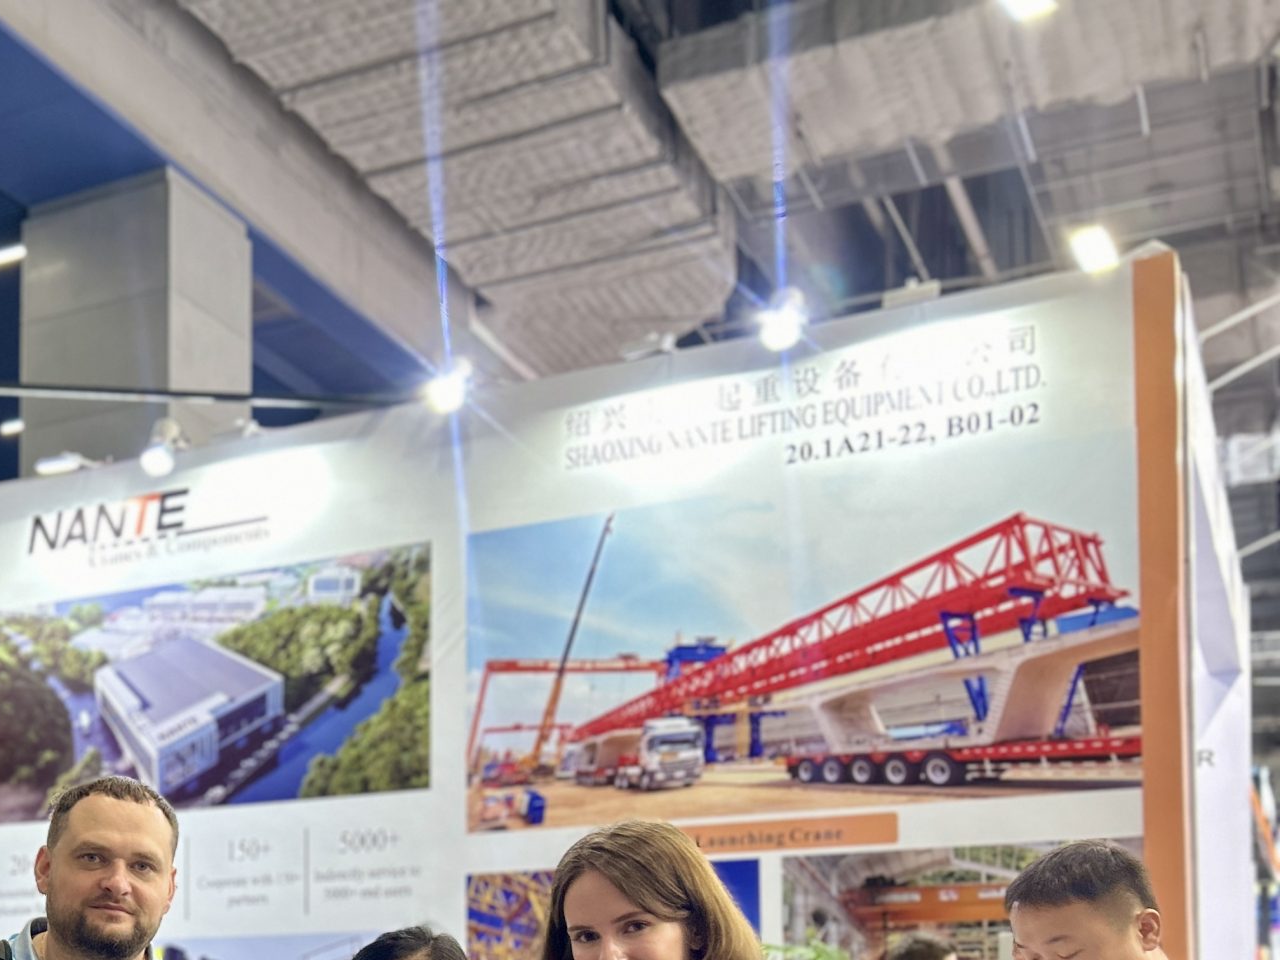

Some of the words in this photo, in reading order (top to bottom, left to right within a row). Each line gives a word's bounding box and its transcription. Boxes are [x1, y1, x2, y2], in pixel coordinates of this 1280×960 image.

[738, 403, 817, 441] LIFTING
[785, 421, 937, 465] 20.1A21-22,
[946, 402, 1041, 438] B01-02
[28, 488, 190, 555] NANTE
[789, 827, 843, 842] Crane
